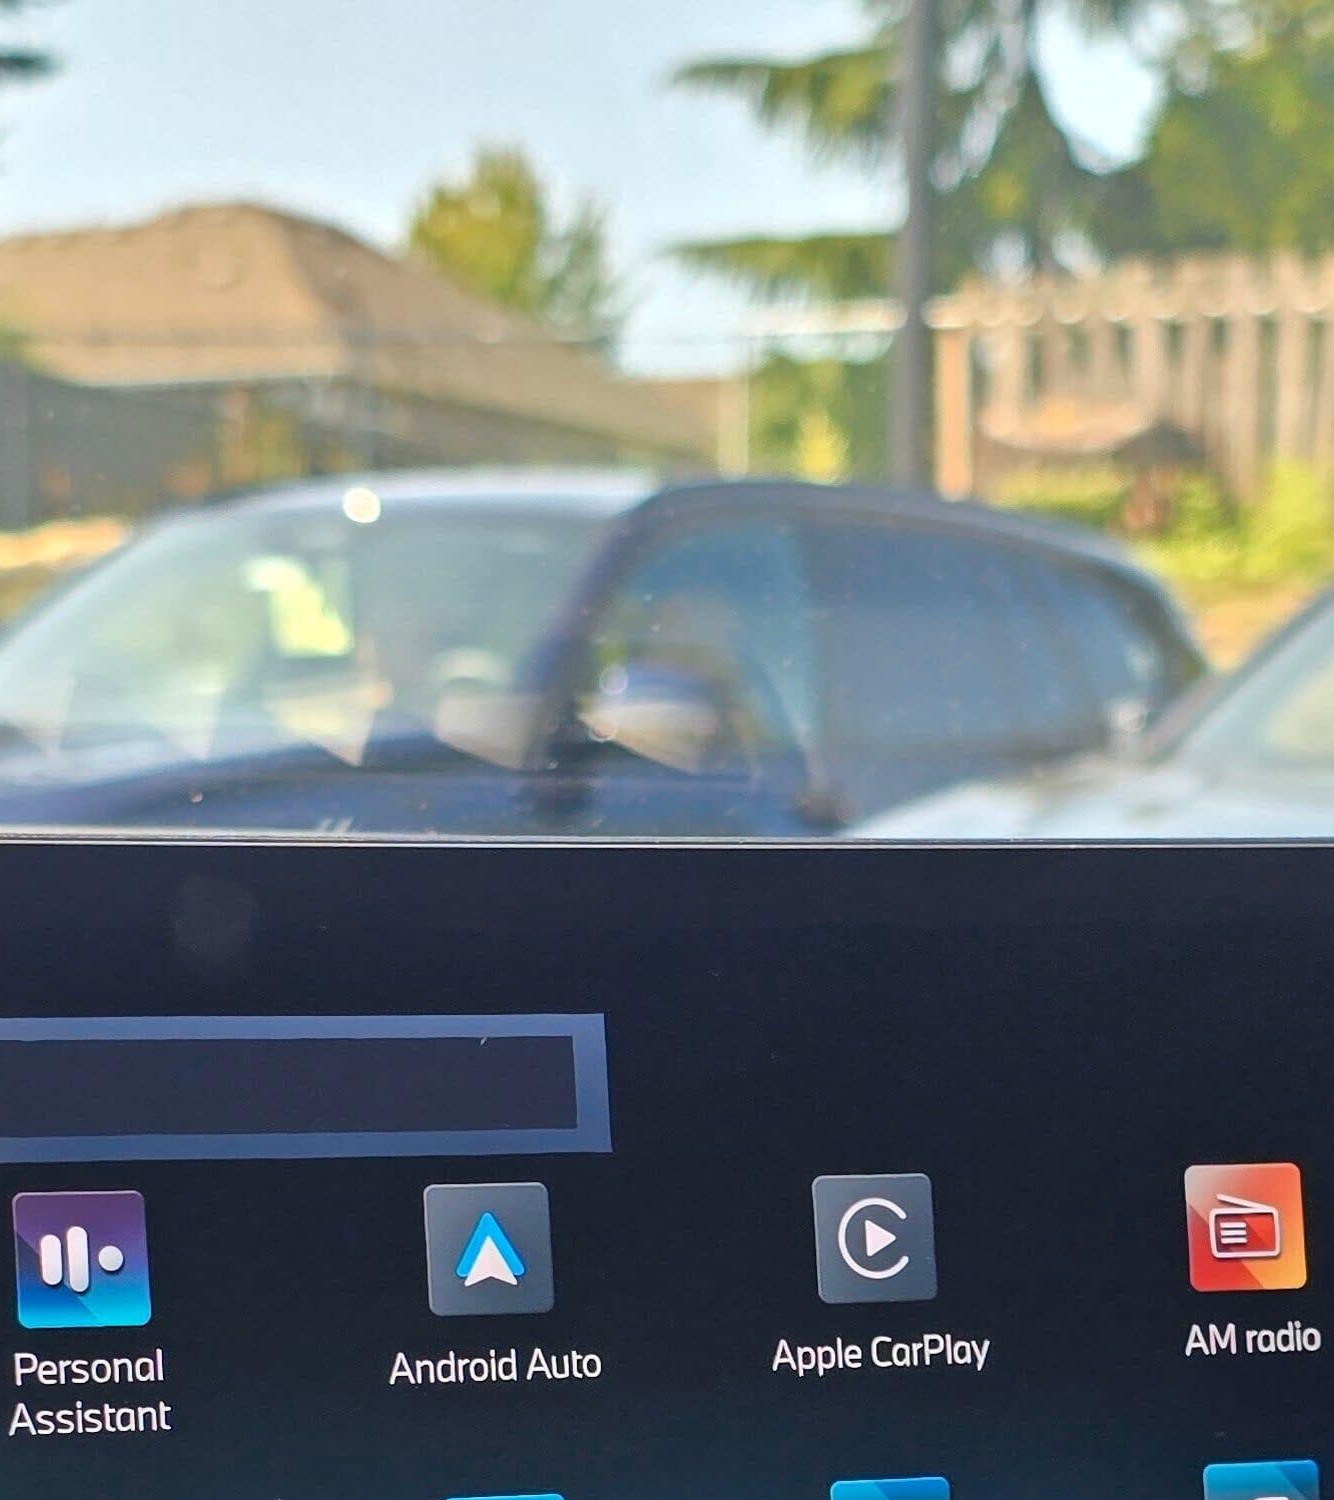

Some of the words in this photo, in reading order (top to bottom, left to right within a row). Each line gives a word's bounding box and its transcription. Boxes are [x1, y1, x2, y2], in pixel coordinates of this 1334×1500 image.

[772, 1337, 862, 1377] Apple
[871, 1333, 990, 1372] CarPlay
[1185, 1322, 1237, 1357] AM
[1245, 1320, 1322, 1354] radio
[14, 1348, 164, 1386] Personal
[389, 1348, 518, 1385] Android
[526, 1347, 602, 1380] Auto
[8, 1400, 172, 1436] Assistant
